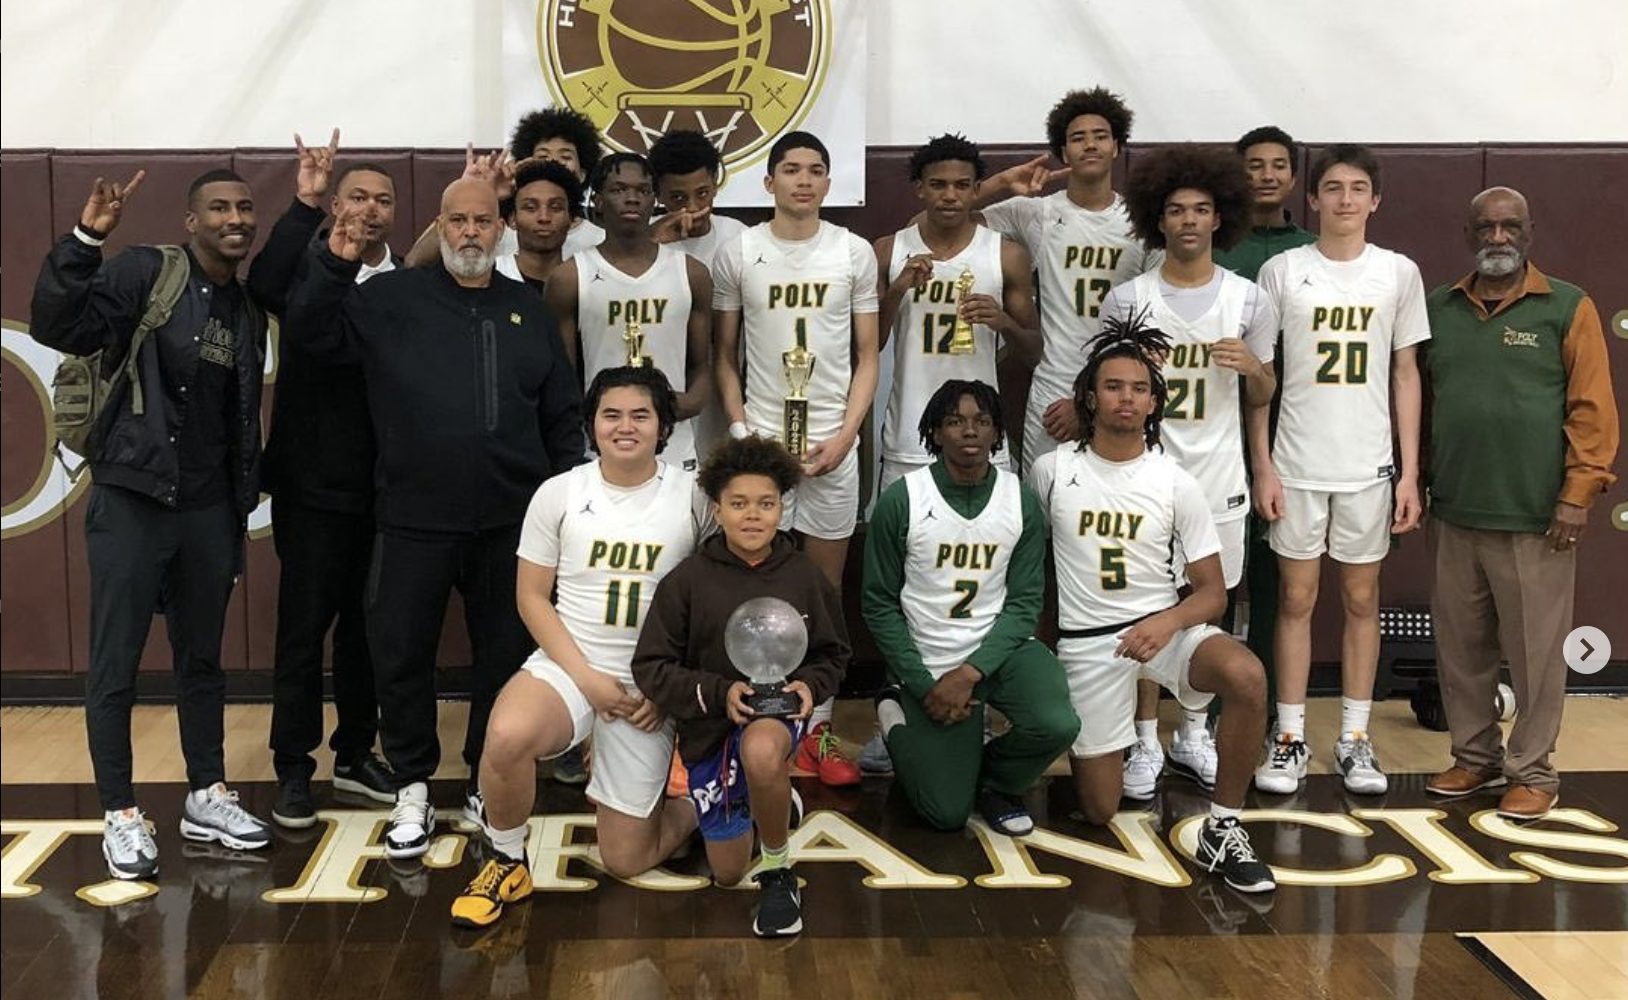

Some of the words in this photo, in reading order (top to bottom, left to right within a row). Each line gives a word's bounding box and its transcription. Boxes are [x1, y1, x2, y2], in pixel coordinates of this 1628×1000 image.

[1064, 244, 1123, 270] POLY
[768, 282, 830, 309] POLY
[912, 279, 956, 304] POL
[1074, 277, 1112, 318] 13
[607, 298, 669, 326] POLY
[1312, 306, 1375, 332] POLY
[794, 316, 808, 352] 1
[923, 312, 957, 354] 12
[1517, 332, 1539, 343] POLY
[1165, 343, 1215, 369] OLY
[1315, 340, 1370, 386] 20
[1163, 378, 1205, 420] 21
[1078, 510, 1144, 541] POLY
[588, 539, 665, 573] POLY
[935, 542, 999, 570] POLY
[1098, 546, 1128, 592] 5
[603, 578, 642, 628] 11
[948, 578, 980, 620] 2
